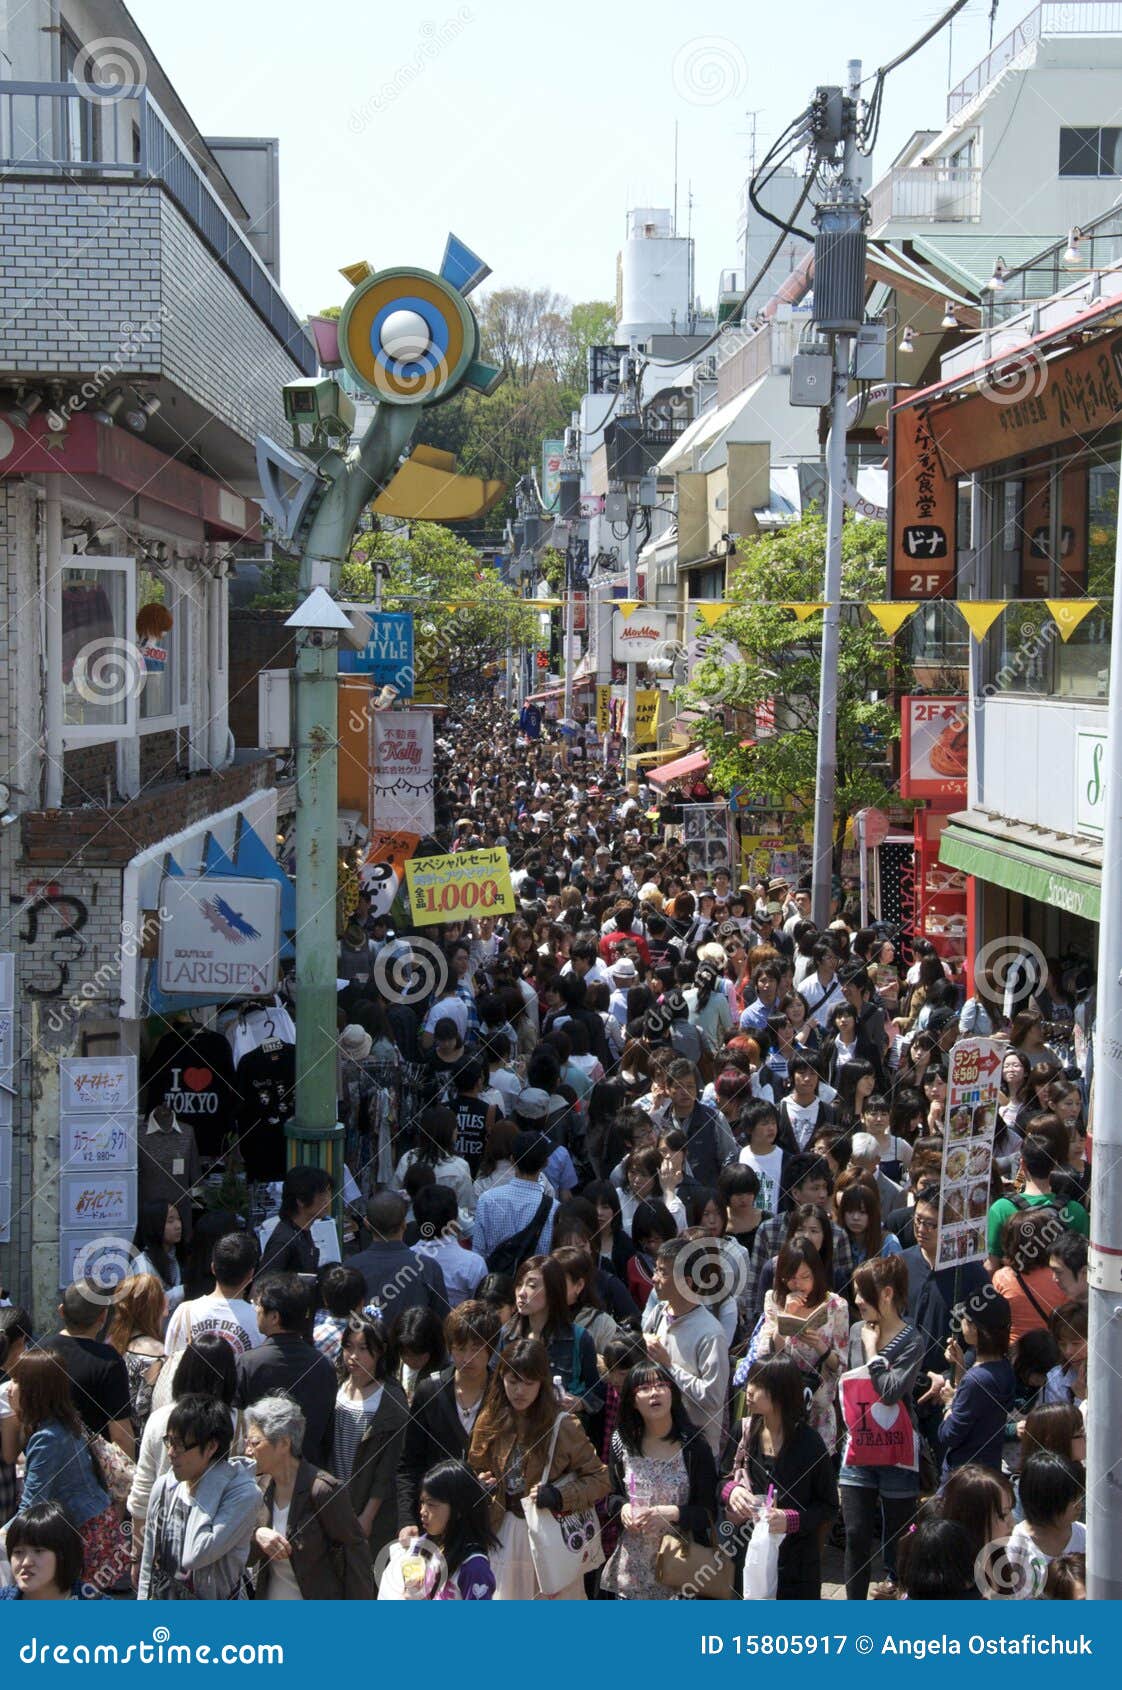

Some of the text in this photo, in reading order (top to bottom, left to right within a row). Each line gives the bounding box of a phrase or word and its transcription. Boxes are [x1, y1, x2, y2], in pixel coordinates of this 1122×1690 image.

[907, 530, 944, 555] ドナ
[909, 575, 940, 592] 2F
[373, 622, 406, 640] ITY
[914, 705, 940, 721] 2F
[378, 741, 423, 765] Kelly
[413, 852, 502, 874] スペシャルセール
[955, 1049, 980, 1067] ランチ
[170, 1067, 183, 1092] I
[164, 1091, 219, 1114] TOKYO
[951, 1083, 998, 1105] Lunch
[191, 1318, 221, 1336] SURF
[856, 1401, 872, 1432] I
